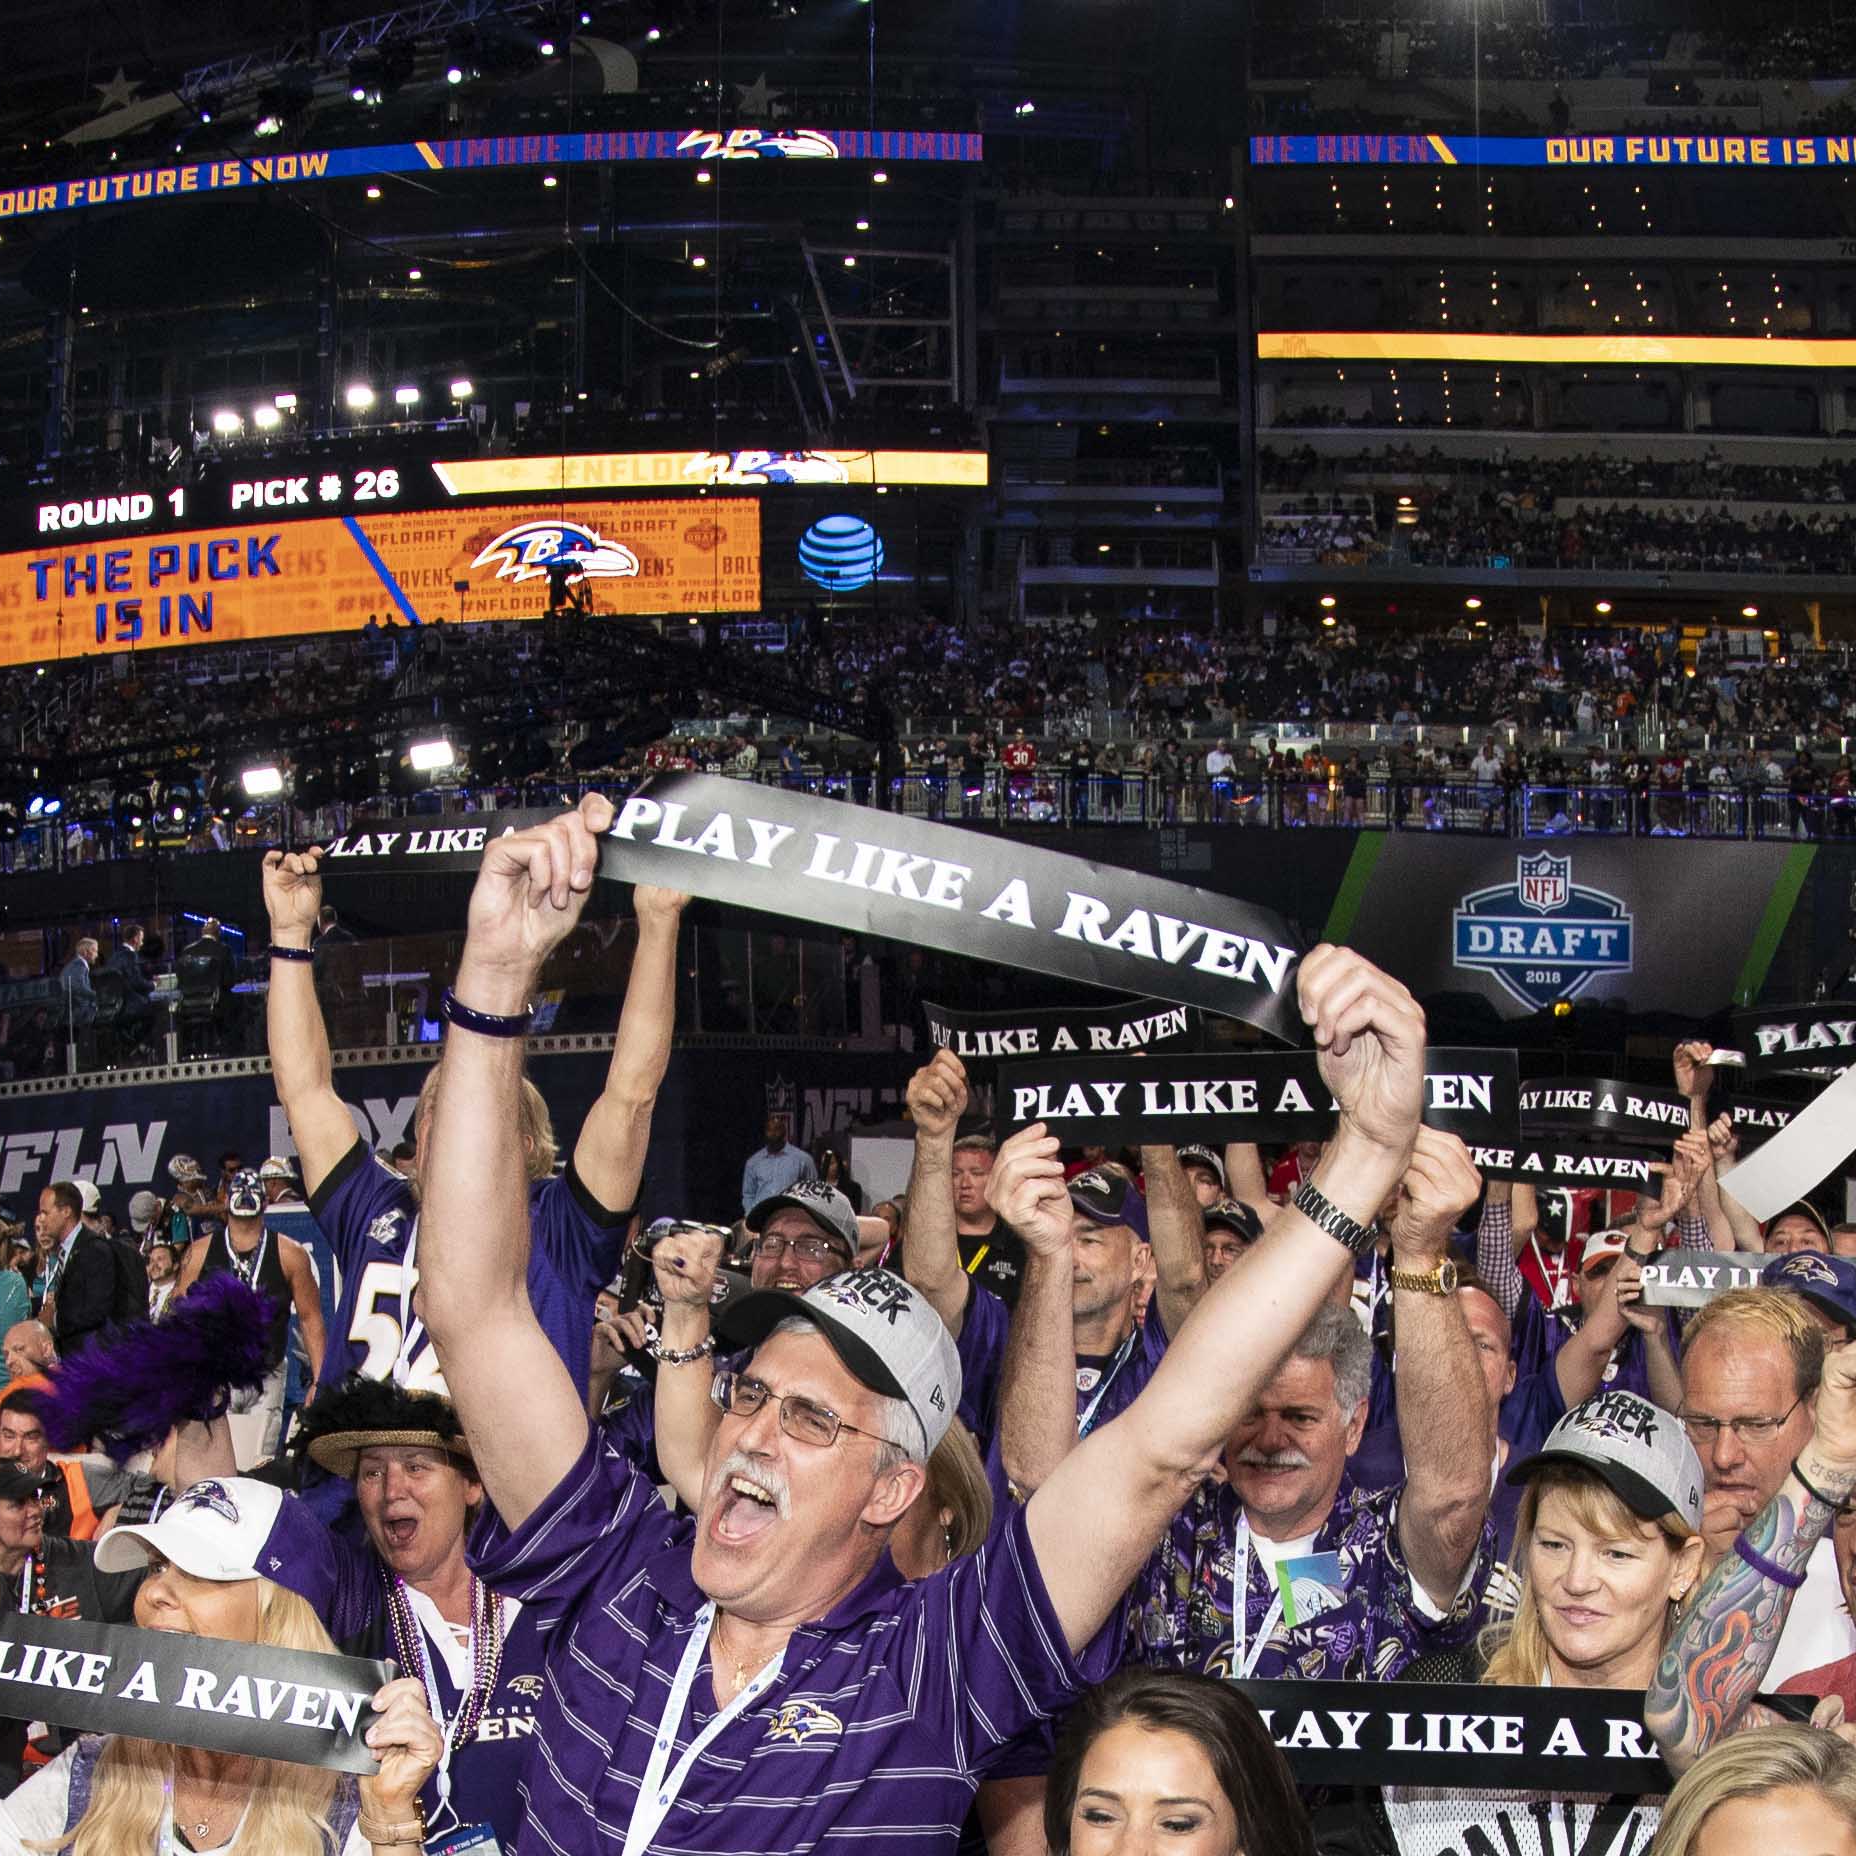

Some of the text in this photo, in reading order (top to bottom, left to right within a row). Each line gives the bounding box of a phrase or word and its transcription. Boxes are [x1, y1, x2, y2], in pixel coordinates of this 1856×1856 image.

[1546, 139, 1615, 164] OUR
[1626, 137, 1771, 164] FUTURE
[1784, 138, 1816, 165] IS
[68, 166, 198, 204] FUTURE
[209, 159, 241, 188] IS
[250, 152, 329, 182] NOW
[38, 494, 154, 532] ROUND
[168, 488, 185, 517] 1
[231, 476, 309, 510] PICK
[319, 473, 342, 502] #
[355, 469, 399, 500] 26
[28, 548, 133, 601] THE
[149, 534, 282, 588] PICK
[96, 591, 213, 644] IS IN
[406, 829, 486, 854] LIKE
[611, 797, 1296, 994] PLAY LIKE A RAVEN
[1525, 878, 1563, 903] NFL
[1469, 925, 1619, 957] DRAFT
[1525, 971, 1561, 984] 2018
[957, 1006, 1189, 1056] LIKE A RAVEN
[1754, 1019, 1856, 1056] PLAY
[1013, 1081, 1126, 1120] PLAY
[1141, 1079, 1259, 1114] LIKE
[1273, 1078, 1314, 1113] A
[1543, 1090, 1690, 1127] LIKE A RAVEN
[1733, 1107, 1791, 1129] PLAY
[1519, 1152, 1650, 1182] A RAVEN
[1640, 1265, 1721, 1289] PLAY
[118, 1662, 161, 1703] A
[177, 1666, 366, 1737] RAVEN
[1387, 1713, 1525, 1756] LIKE
[1542, 1723, 1584, 1757] A
